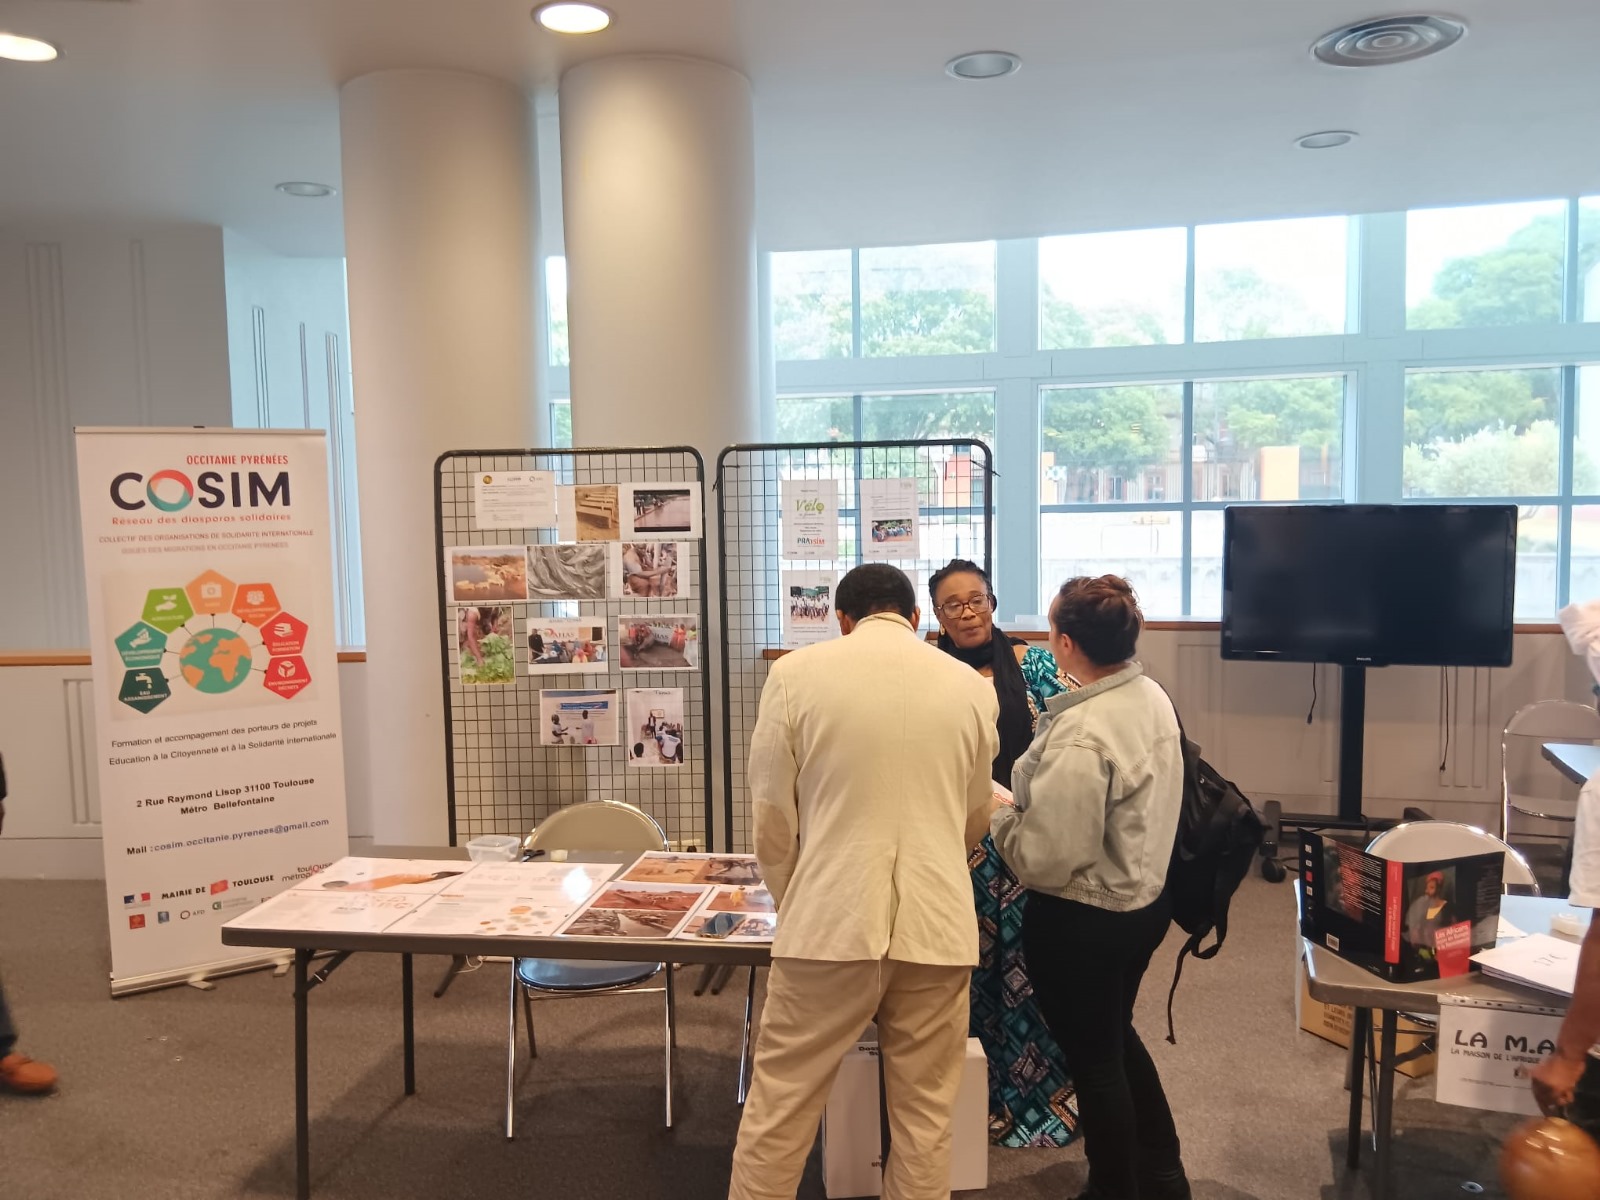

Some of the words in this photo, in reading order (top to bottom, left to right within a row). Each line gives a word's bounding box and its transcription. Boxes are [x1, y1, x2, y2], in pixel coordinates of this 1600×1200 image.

[186, 455, 237, 465] OCCITANIE
[241, 454, 289, 465] PYRÉNÉES
[110, 469, 291, 512] COSIM
[158, 515, 177, 525] des
[240, 513, 291, 522] solidaires
[111, 738, 152, 748] Formation
[154, 736, 162, 744] et
[231, 727, 245, 735] des
[247, 724, 279, 734] porteurs
[293, 719, 318, 728] projets
[109, 754, 151, 765] Education
[161, 752, 168, 760] la
[170, 746, 219, 759] Citoyenneté
[248, 738, 284, 749] Solidarité
[136, 800, 142, 808] 2
[145, 798, 165, 807] Rue
[167, 791, 213, 805] Raymond
[215, 786, 242, 798] Lisop
[244, 783, 271, 793] 31100
[273, 778, 315, 789] Toulouse
[180, 804, 208, 815] Métro
[213, 795, 275, 811] Bellefontaine
[126, 846, 147, 855] Mail
[161, 889, 193, 900] MAIRIE
[232, 874, 275, 888] TOULOUSE
[1455, 1029, 1488, 1049] LA
[1463, 1049, 1491, 1060] MAISON
